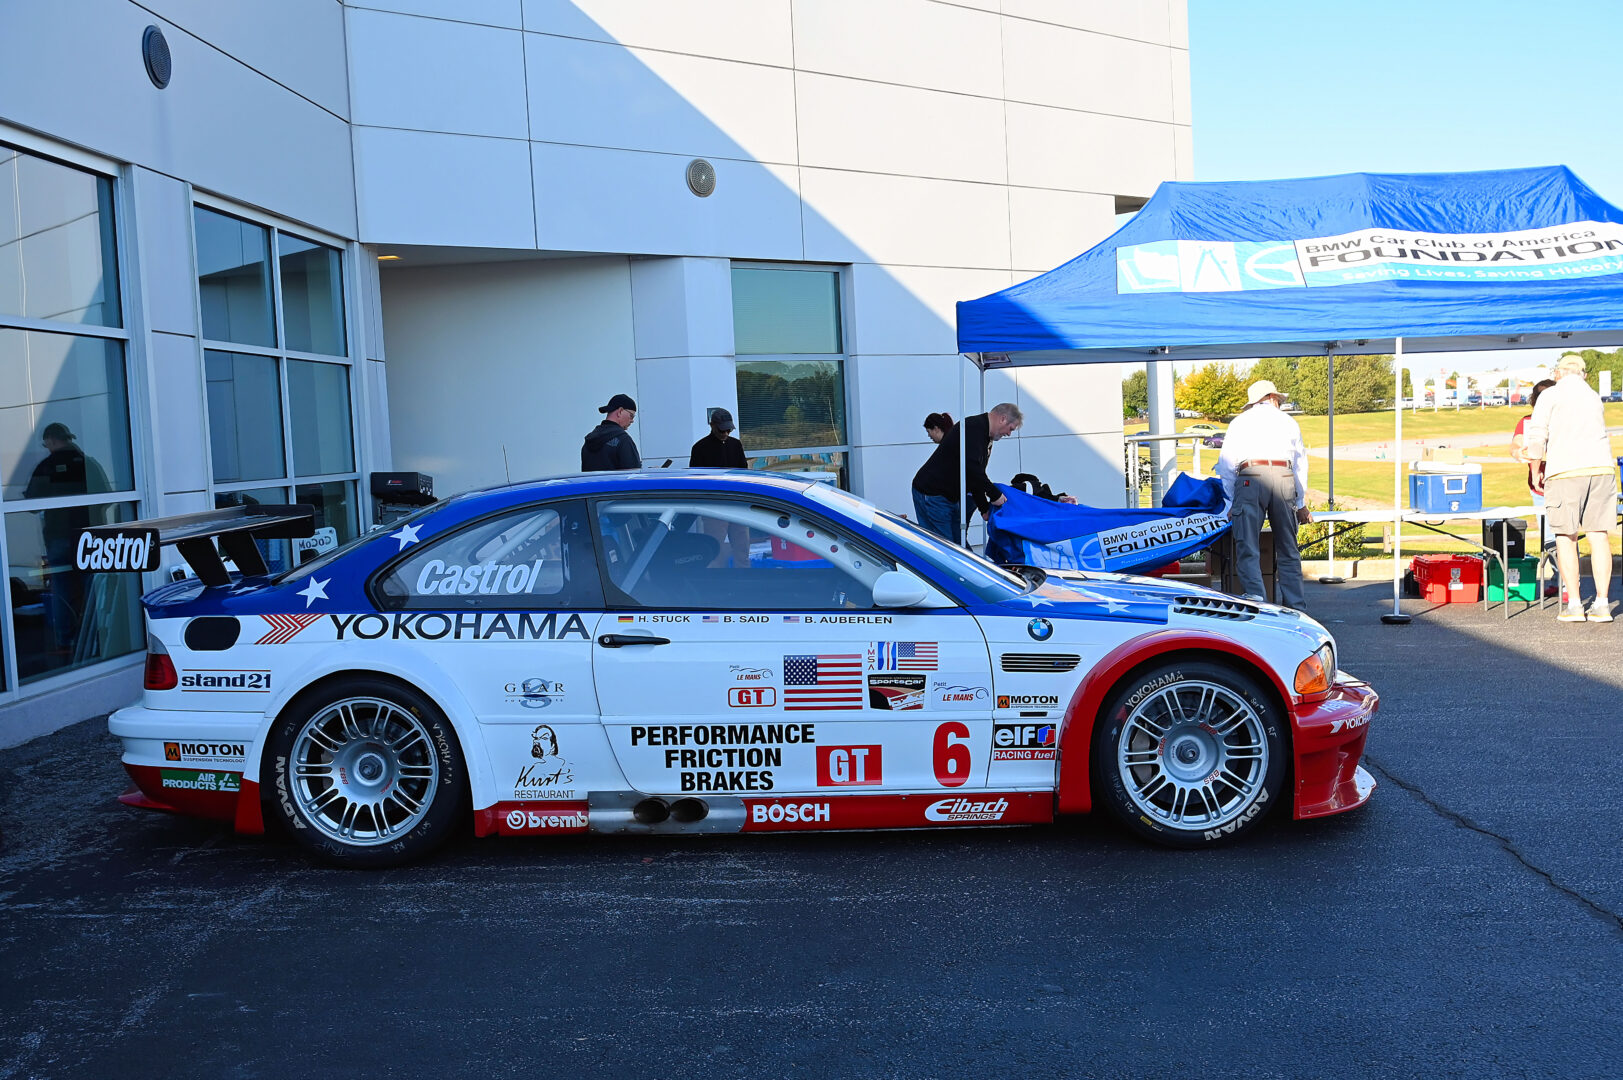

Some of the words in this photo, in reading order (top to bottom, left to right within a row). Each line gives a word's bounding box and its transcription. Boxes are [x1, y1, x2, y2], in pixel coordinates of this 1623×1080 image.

[1305, 238, 1362, 254] BMW
[1369, 235, 1407, 245] Car
[1414, 238, 1466, 249] Club
[1473, 240, 1494, 249] of
[1501, 229, 1596, 248] America
[1342, 268, 1411, 281] Saving
[1474, 268, 1545, 278] Saving
[1102, 531, 1129, 546] BMW
[1130, 528, 1148, 539] Car
[1150, 522, 1174, 534] Club
[1175, 517, 1186, 528] of
[76, 531, 152, 571] Castrol
[416, 558, 544, 595] Castrol
[330, 613, 591, 640] YOKOHAMA
[638, 615, 650, 623] H.
[652, 615, 691, 623] STUCK
[723, 615, 735, 623] B.
[739, 615, 770, 623] SAID
[805, 616, 817, 624] B.
[820, 616, 893, 624] AUBERLEN
[504, 682, 566, 693] GEAR
[737, 689, 765, 705] GT
[942, 693, 952, 702] LE
[953, 693, 974, 702] MANS
[1125, 670, 1185, 708] YOKOHAMA
[1010, 695, 1059, 704] MOTON
[630, 723, 815, 746] PERFORMANCE
[994, 725, 1036, 746] elf
[181, 744, 245, 756] MOTON
[665, 747, 781, 768] FRICTION
[932, 721, 971, 788] 6
[994, 750, 1032, 759] RACING
[1034, 750, 1055, 759] fuel
[829, 748, 869, 783] GT
[162, 779, 217, 790] PRODUCTS
[197, 773, 216, 782] AIR
[514, 765, 575, 788] Kurt's
[680, 771, 774, 792] BRAKES
[1203, 769, 1221, 785] BBS
[275, 756, 308, 829] ADVAN
[514, 789, 575, 799] RESTAURANT
[752, 803, 830, 823] BOSCH
[924, 797, 1009, 819] Eibach
[947, 813, 997, 821] SPRINGS
[1203, 786, 1270, 841] ADVAN
